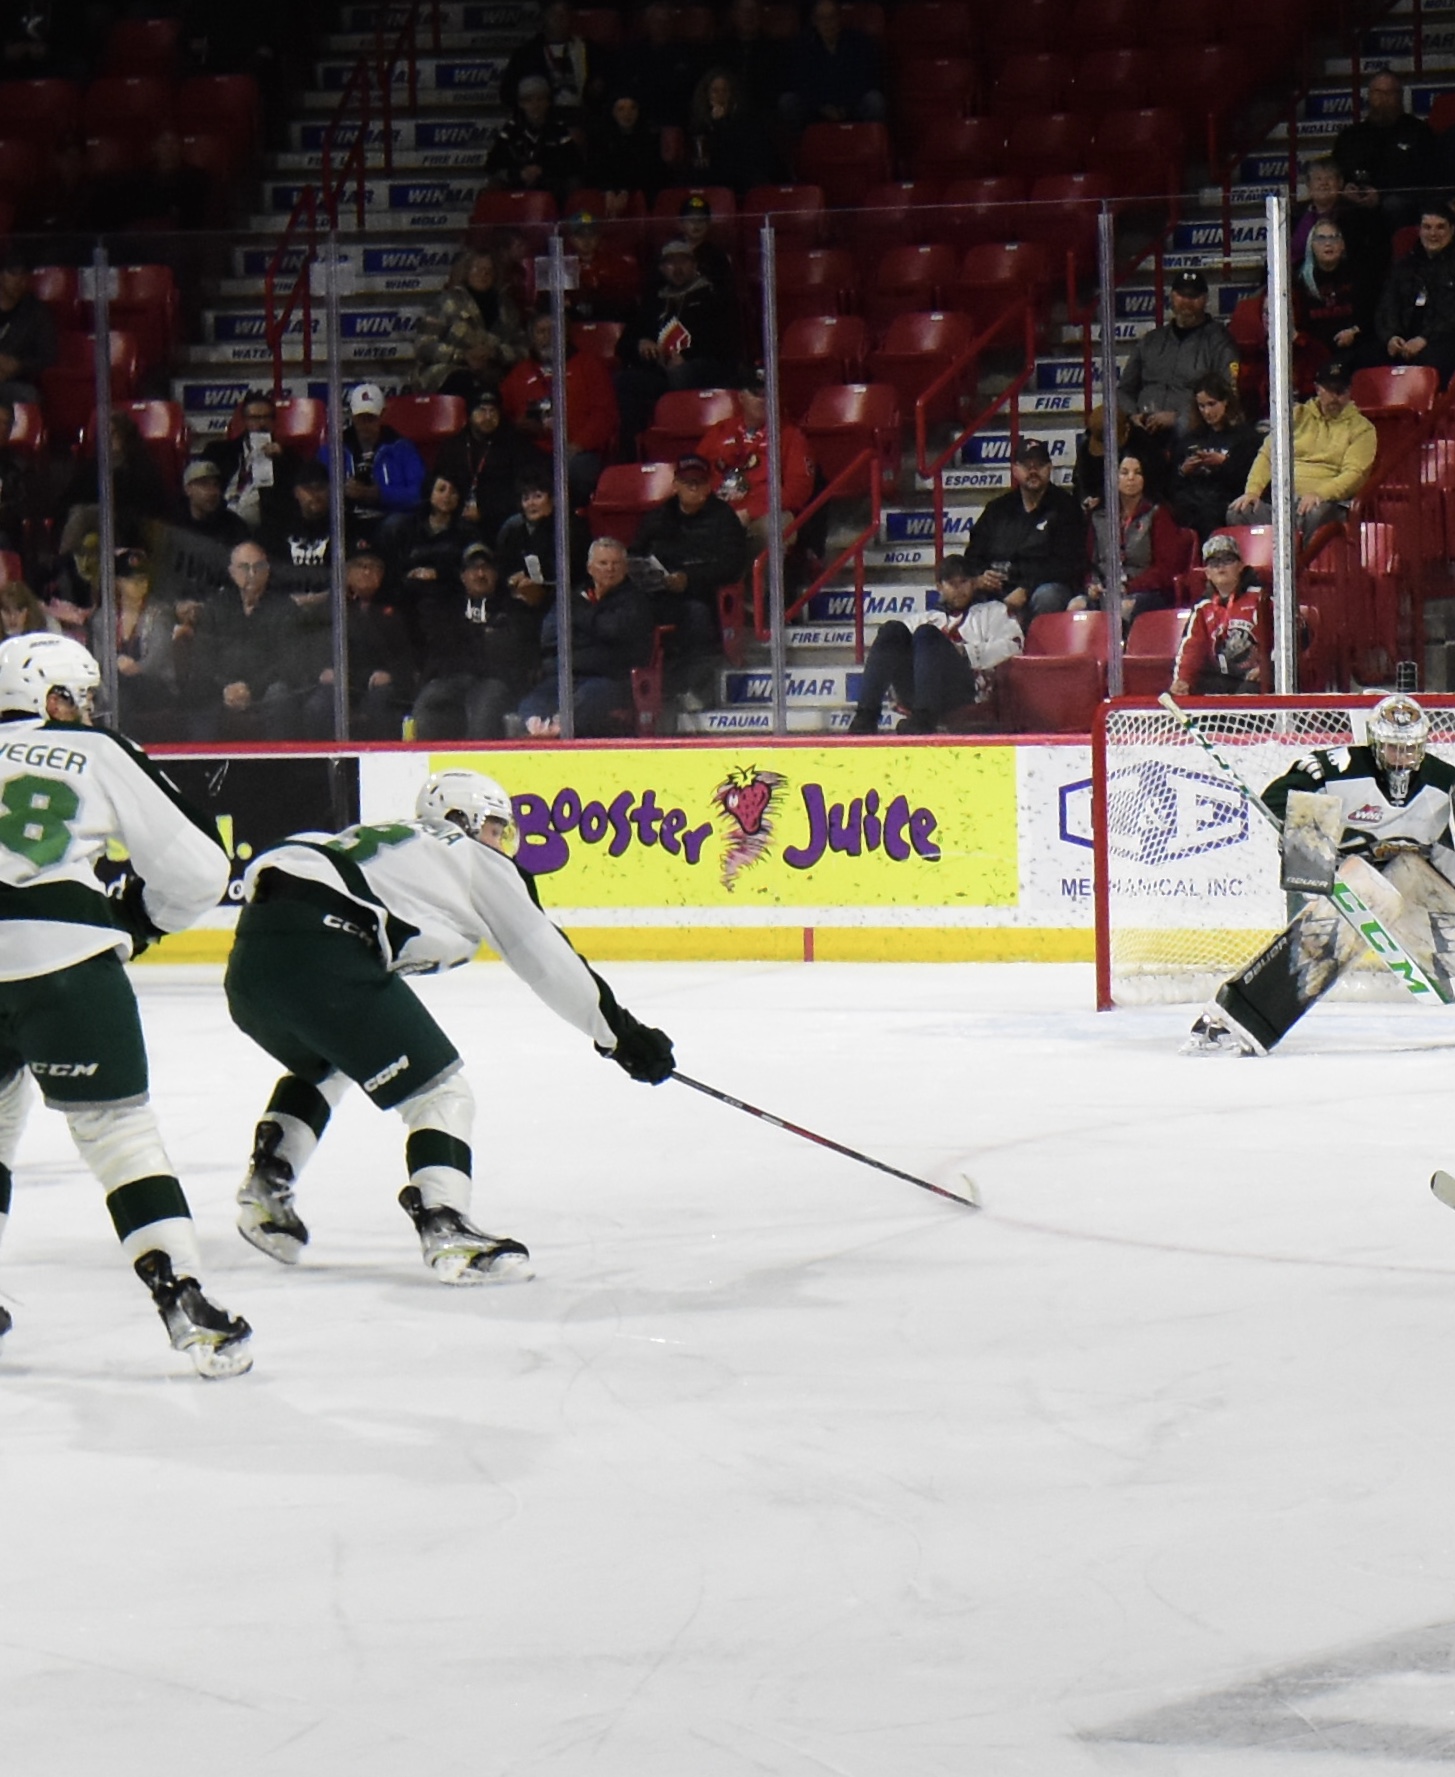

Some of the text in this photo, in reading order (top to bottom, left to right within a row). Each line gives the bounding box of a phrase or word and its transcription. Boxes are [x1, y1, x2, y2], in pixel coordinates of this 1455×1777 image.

[410, 215, 448, 227] MOLD
[384, 279, 421, 290] WIND
[353, 346, 398, 358] WATER
[1035, 397, 1071, 409] FIRE
[945, 474, 1004, 486] ESPORTA
[884, 552, 921, 564] MOLD
[791, 631, 853, 644] FIRE LINE
[746, 678, 835, 698] WIMAR
[708, 715, 769, 728] TRAUMA
[511, 787, 712, 876] Booster
[782, 783, 942, 869] Juice
[1333, 881, 1431, 996] CCM
[31, 1062, 98, 1077] CCM
[363, 1055, 410, 1093] CCM
